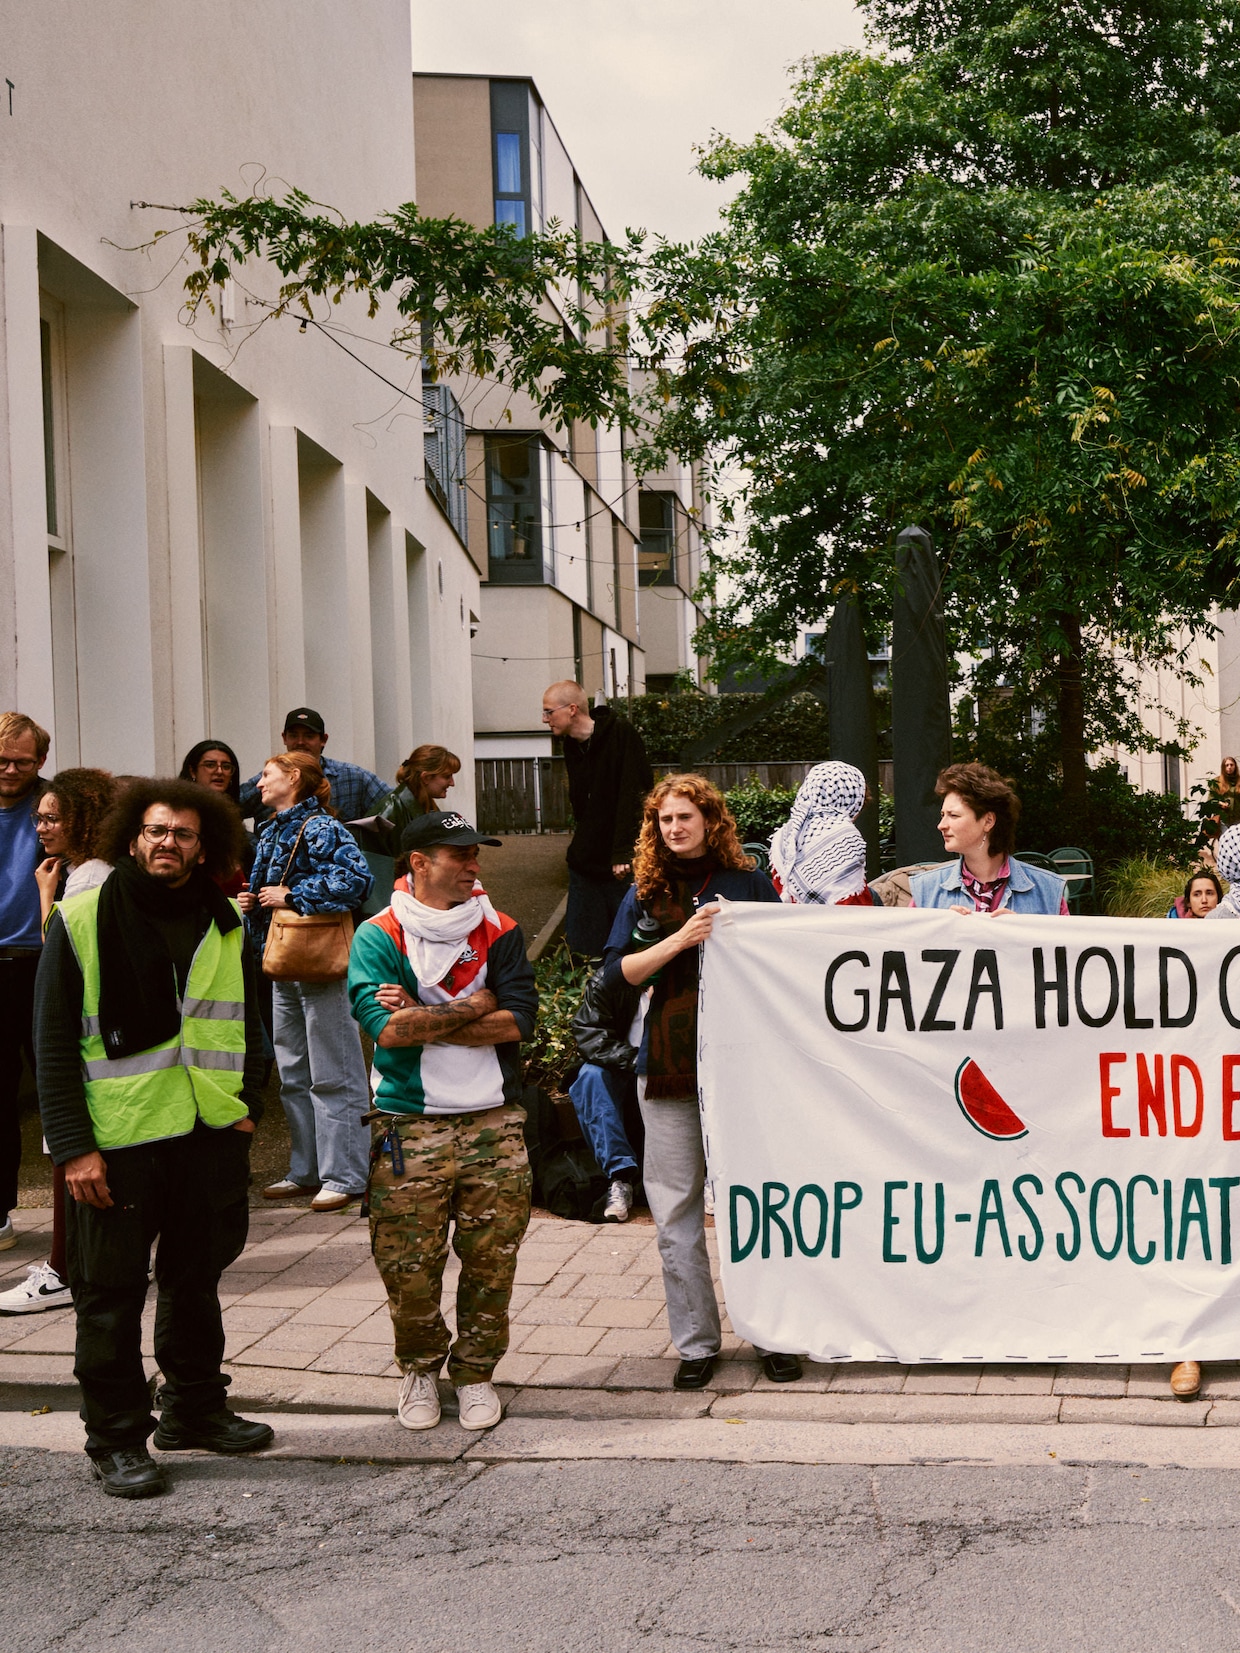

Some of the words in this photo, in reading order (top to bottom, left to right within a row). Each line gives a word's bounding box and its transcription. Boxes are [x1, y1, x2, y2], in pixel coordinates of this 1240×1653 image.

[824, 948, 1003, 1032] GAZA
[1032, 944, 1198, 1029] HOLD
[1101, 1053, 1203, 1138] END
[730, 1181, 863, 1264] DROP
